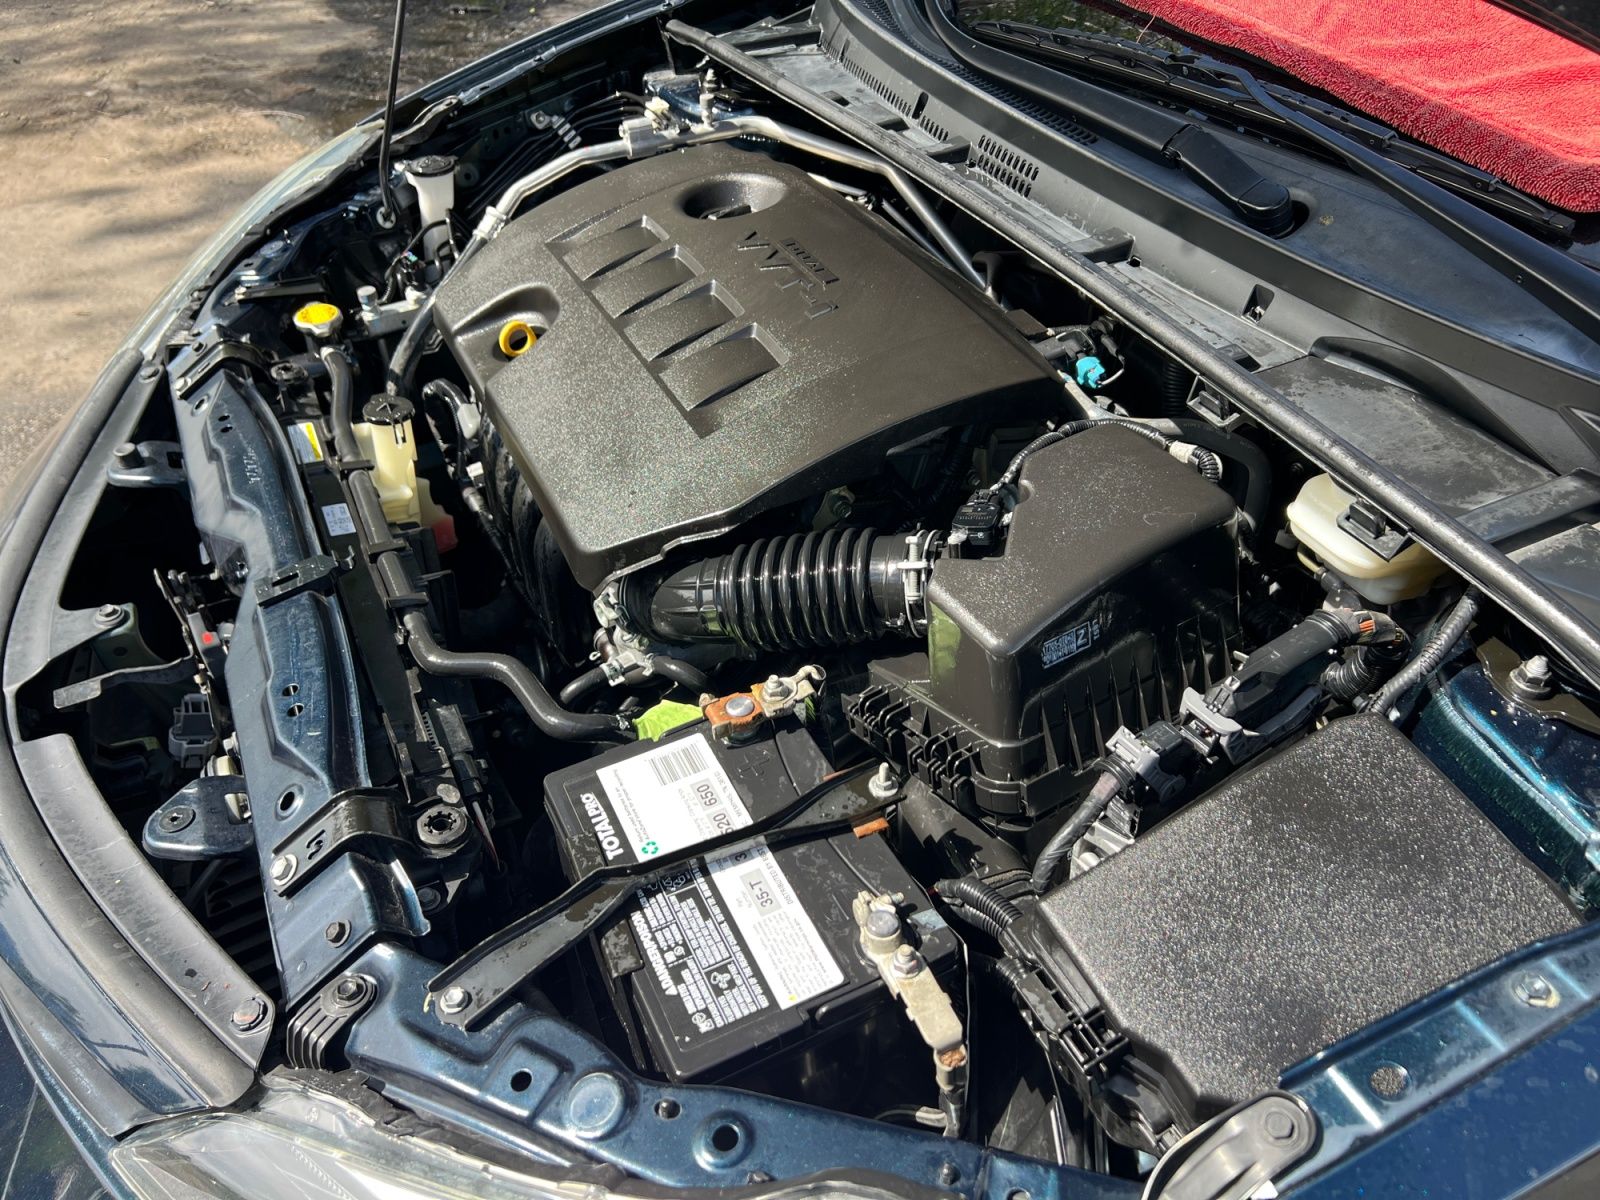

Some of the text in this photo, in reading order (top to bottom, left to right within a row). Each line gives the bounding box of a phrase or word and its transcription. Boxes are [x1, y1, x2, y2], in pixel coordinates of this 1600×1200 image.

[696, 784, 718, 807] 650
[580, 792, 624, 861] TOTALPRO
[749, 880, 773, 908] 35-T
[630, 910, 673, 989] DANGER/POISON
